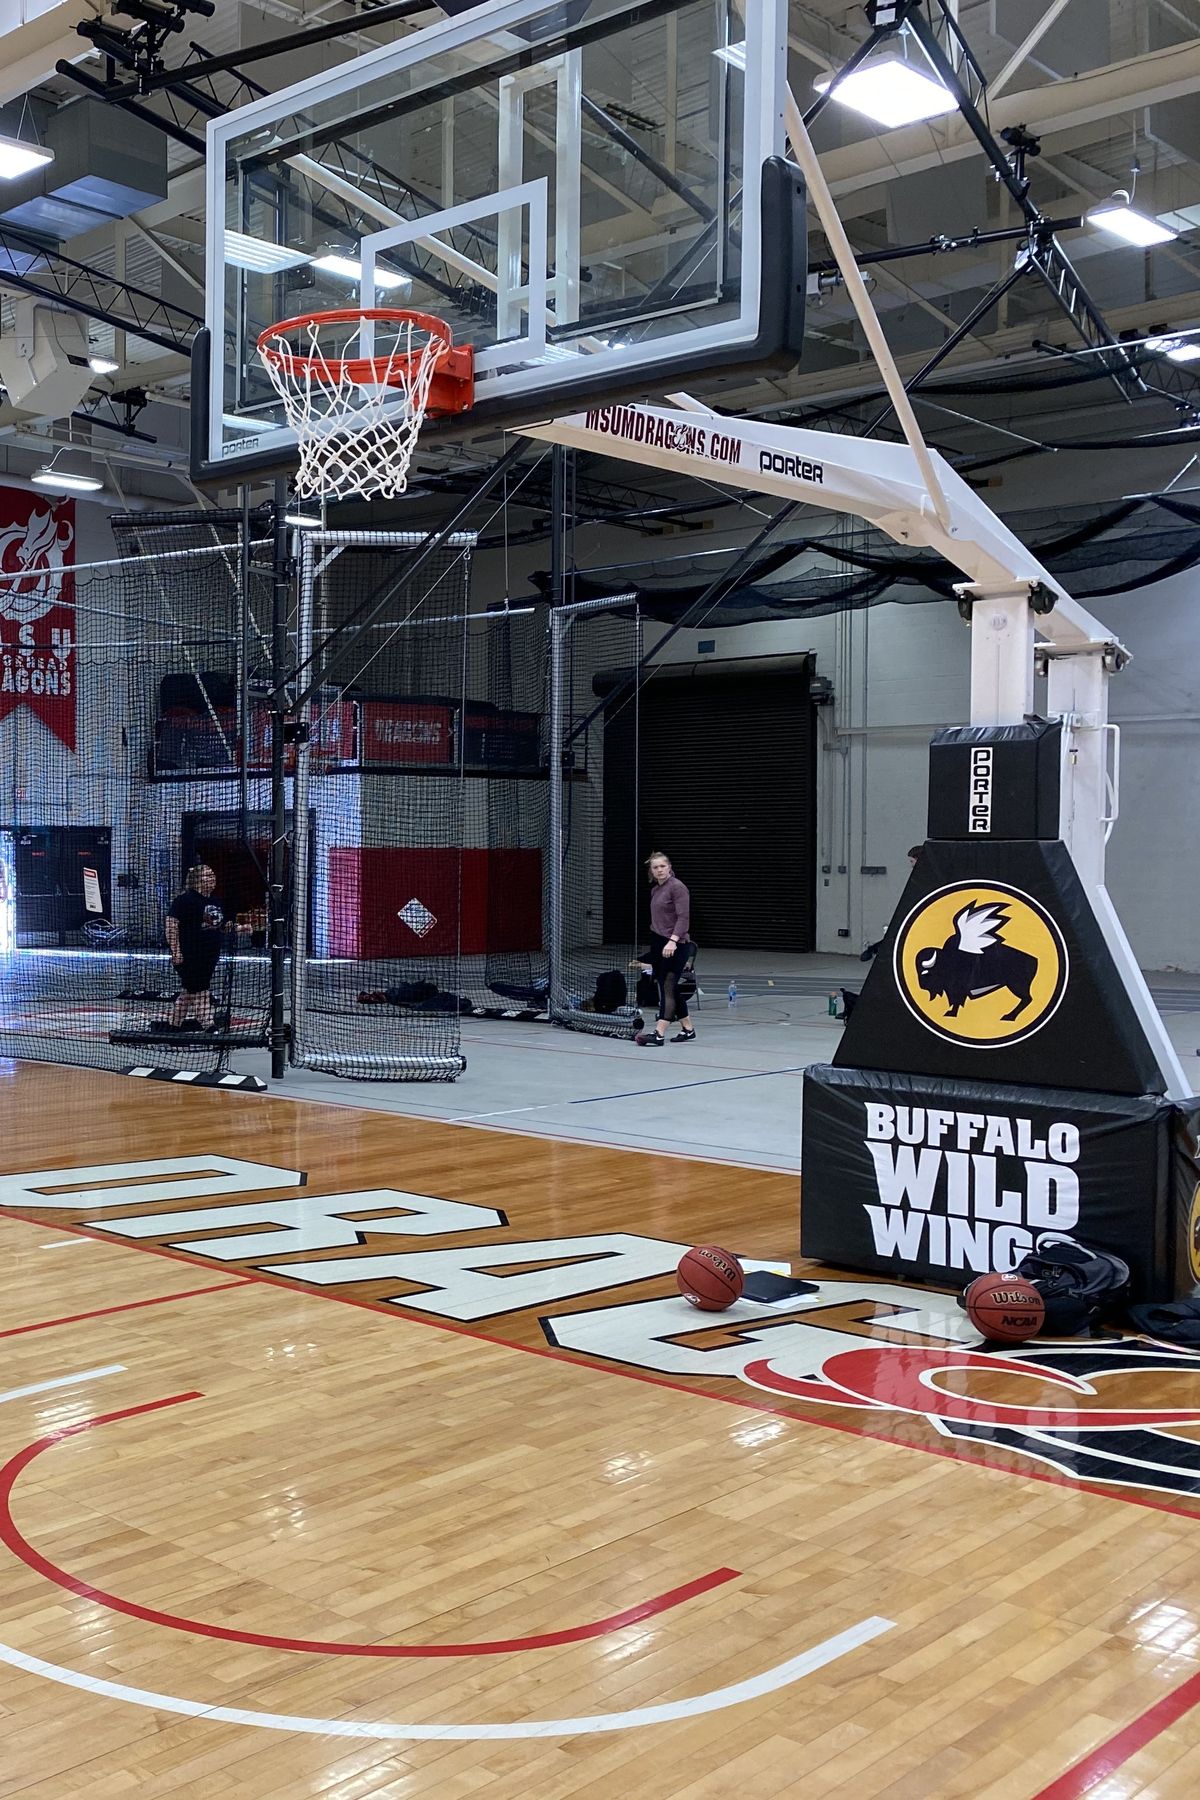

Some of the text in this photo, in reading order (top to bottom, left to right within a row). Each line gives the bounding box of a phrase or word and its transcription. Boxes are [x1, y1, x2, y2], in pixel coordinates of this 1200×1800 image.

[863, 1101, 1081, 1164] BUFFALO
[863, 1140, 1080, 1231] WILD
[862, 1203, 1077, 1275] WING
[698, 1249, 737, 1283] Wilson
[991, 1291, 1041, 1306] Wilson
[1002, 1315, 1038, 1327] NCAA
